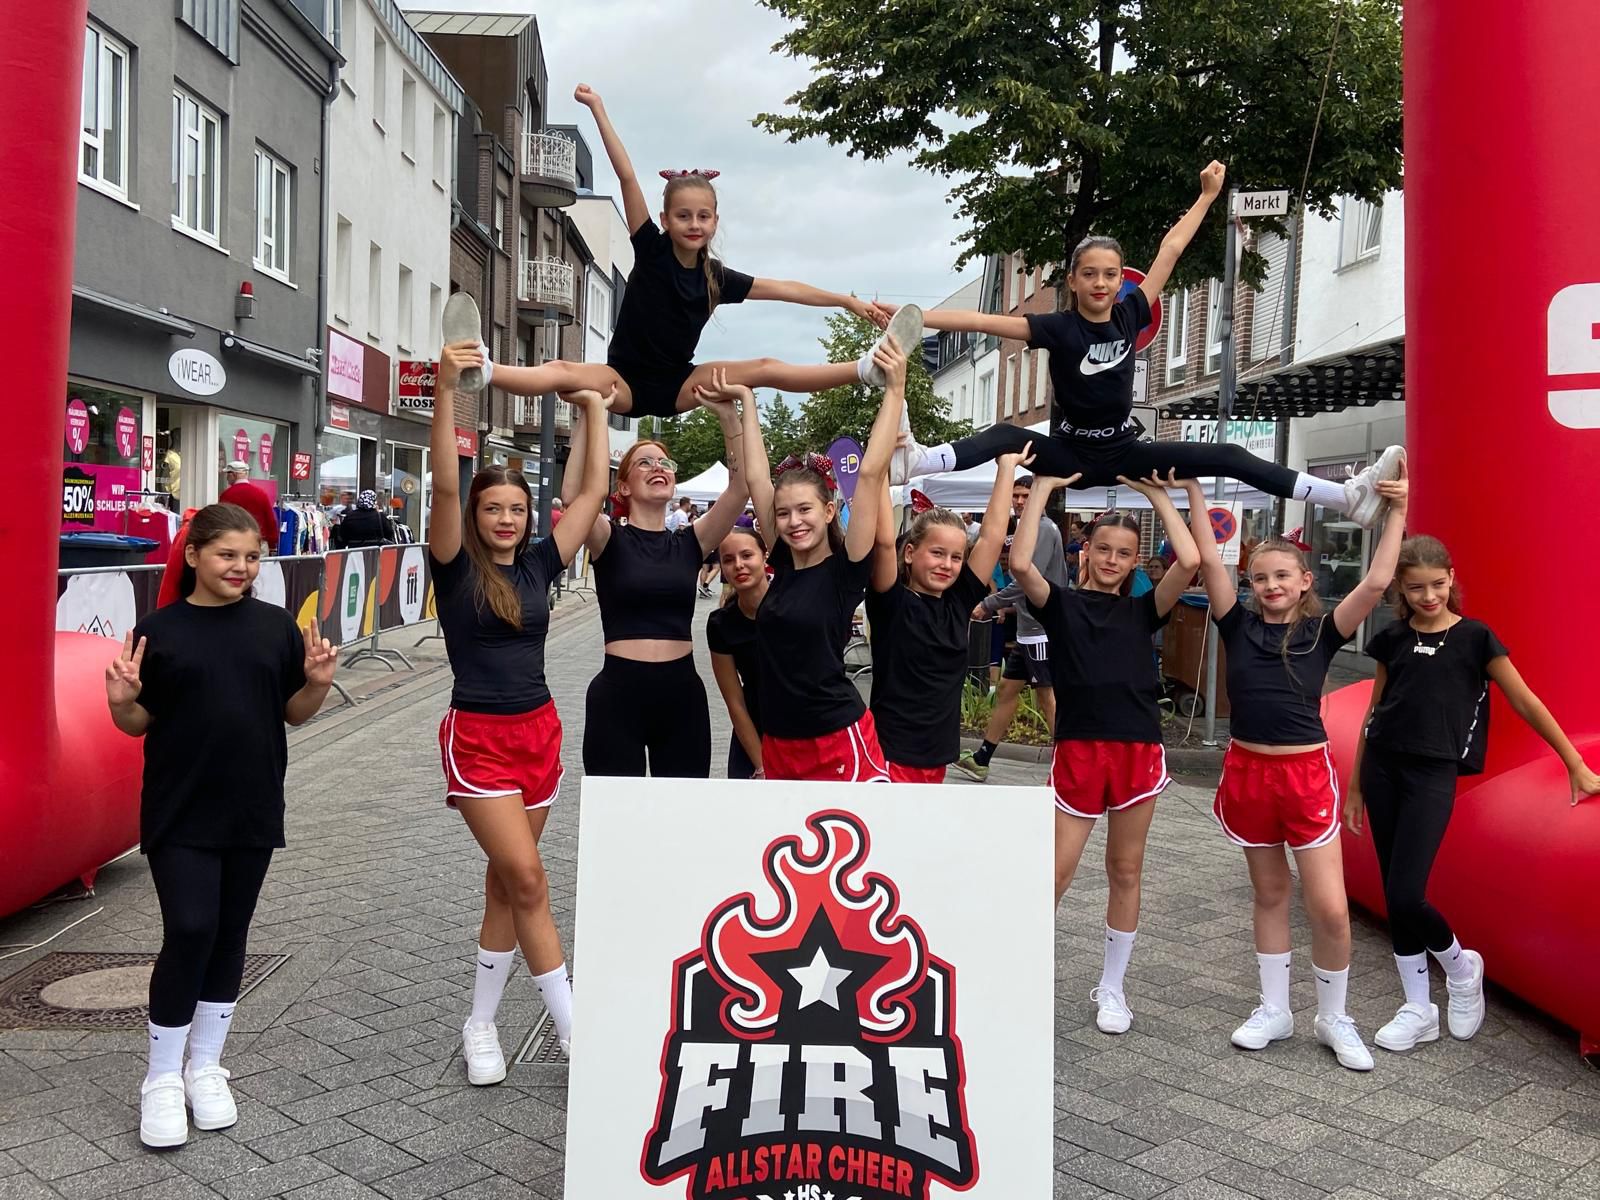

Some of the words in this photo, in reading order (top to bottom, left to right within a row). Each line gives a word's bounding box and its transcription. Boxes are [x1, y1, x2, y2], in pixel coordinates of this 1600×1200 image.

[1244, 195, 1280, 210] Markt
[1088, 339, 1126, 362] NIKE
[400, 398, 435, 408] KIOSK
[1075, 427, 1115, 438] PRO
[1226, 420, 1274, 440] PHONE
[295, 453, 310, 463] SALE
[111, 484, 125, 495] WIR
[63, 485, 94, 512] 50%
[96, 500, 139, 512] SCHLIESEN
[657, 1041, 962, 1173] FIRE
[705, 1143, 822, 1194] ALLSTAR
[828, 1145, 914, 1197] CHEER
[797, 1184, 820, 1200] HS
